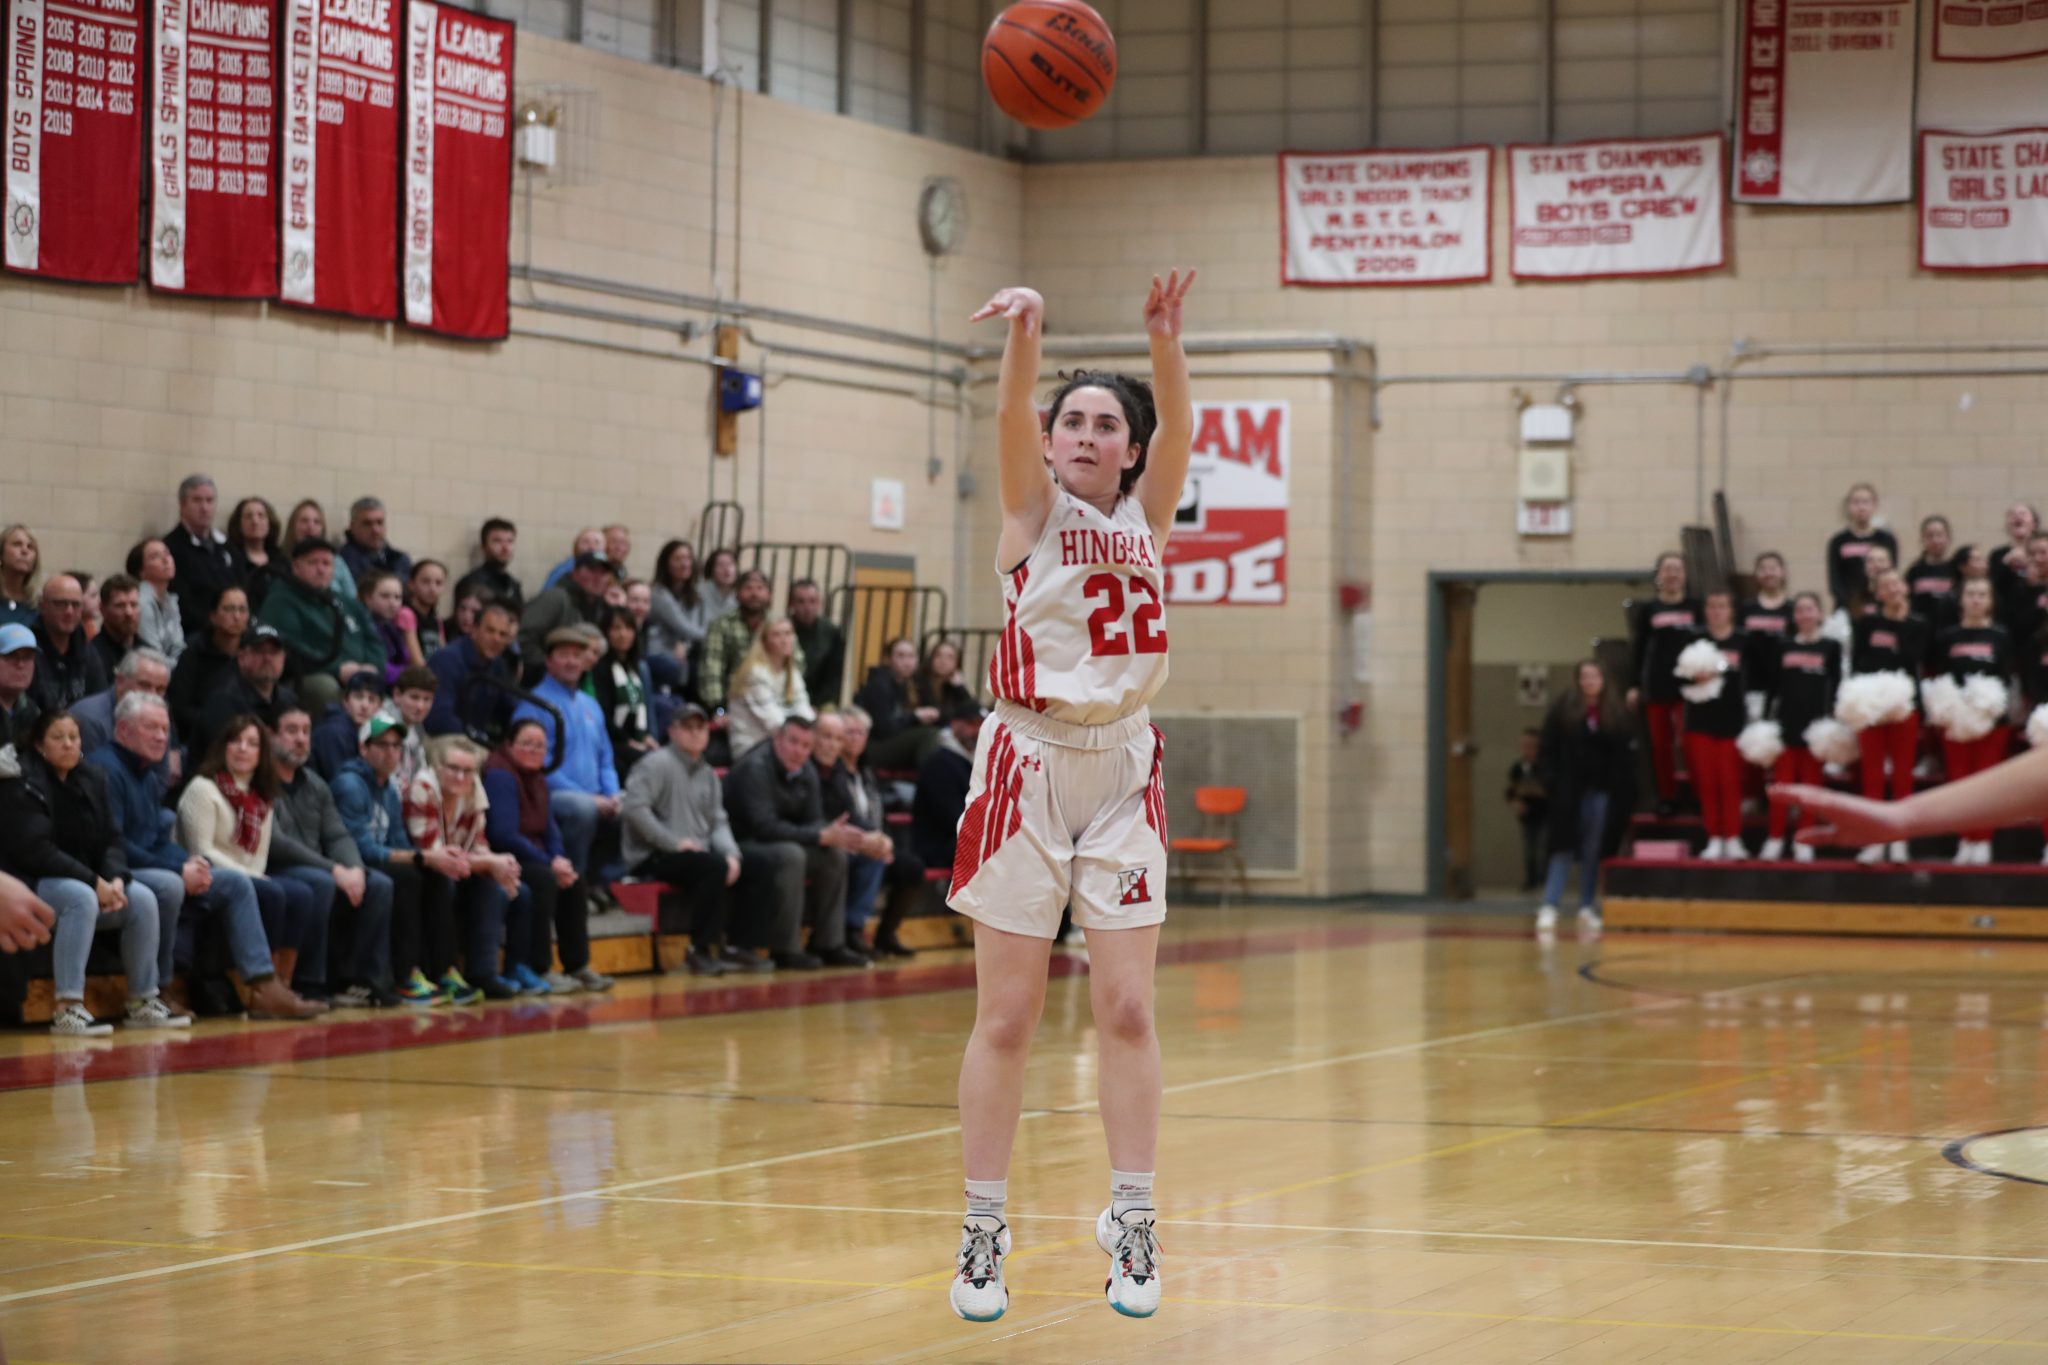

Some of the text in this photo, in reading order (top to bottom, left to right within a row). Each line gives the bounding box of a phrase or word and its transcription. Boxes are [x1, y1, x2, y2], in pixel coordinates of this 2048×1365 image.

[47, 16, 136, 55] 2005 2006 2007
[191, 0, 269, 40] CHAMPIONS
[322, 0, 391, 32] LEAGUE
[320, 21, 393, 71] CHAMPIONS
[439, 17, 504, 65] LEAGUE
[46, 47, 135, 86] 2008 2010 2012
[161, 44, 180, 124] SPRING
[435, 55, 506, 102] CHAMPIONS
[12, 15, 36, 174] BOYS SPRING
[45, 78, 73, 105] 2013
[76, 84, 104, 111] 2014
[189, 76, 214, 101] 2007
[43, 109, 73, 136] 2019
[412, 23, 428, 250] BOYS BASKETBALL
[160, 133, 180, 199] GIRLS
[1302, 158, 1470, 184] STATE CHAMPIONS
[1530, 146, 1703, 174] STATE CHAMPIONS
[1942, 144, 2004, 170] STATE
[291, 157, 309, 231] GIRLS
[1948, 176, 2006, 201] GIRLS
[1536, 196, 1697, 222] BOYS CREW
[1310, 232, 1461, 252] PENTATHLON
[1192, 409, 1282, 479] AM
[1059, 529, 1156, 568] HINGHA
[1163, 537, 1284, 603] DE
[1083, 572, 1168, 656] 22
[1117, 867, 1152, 906] H
